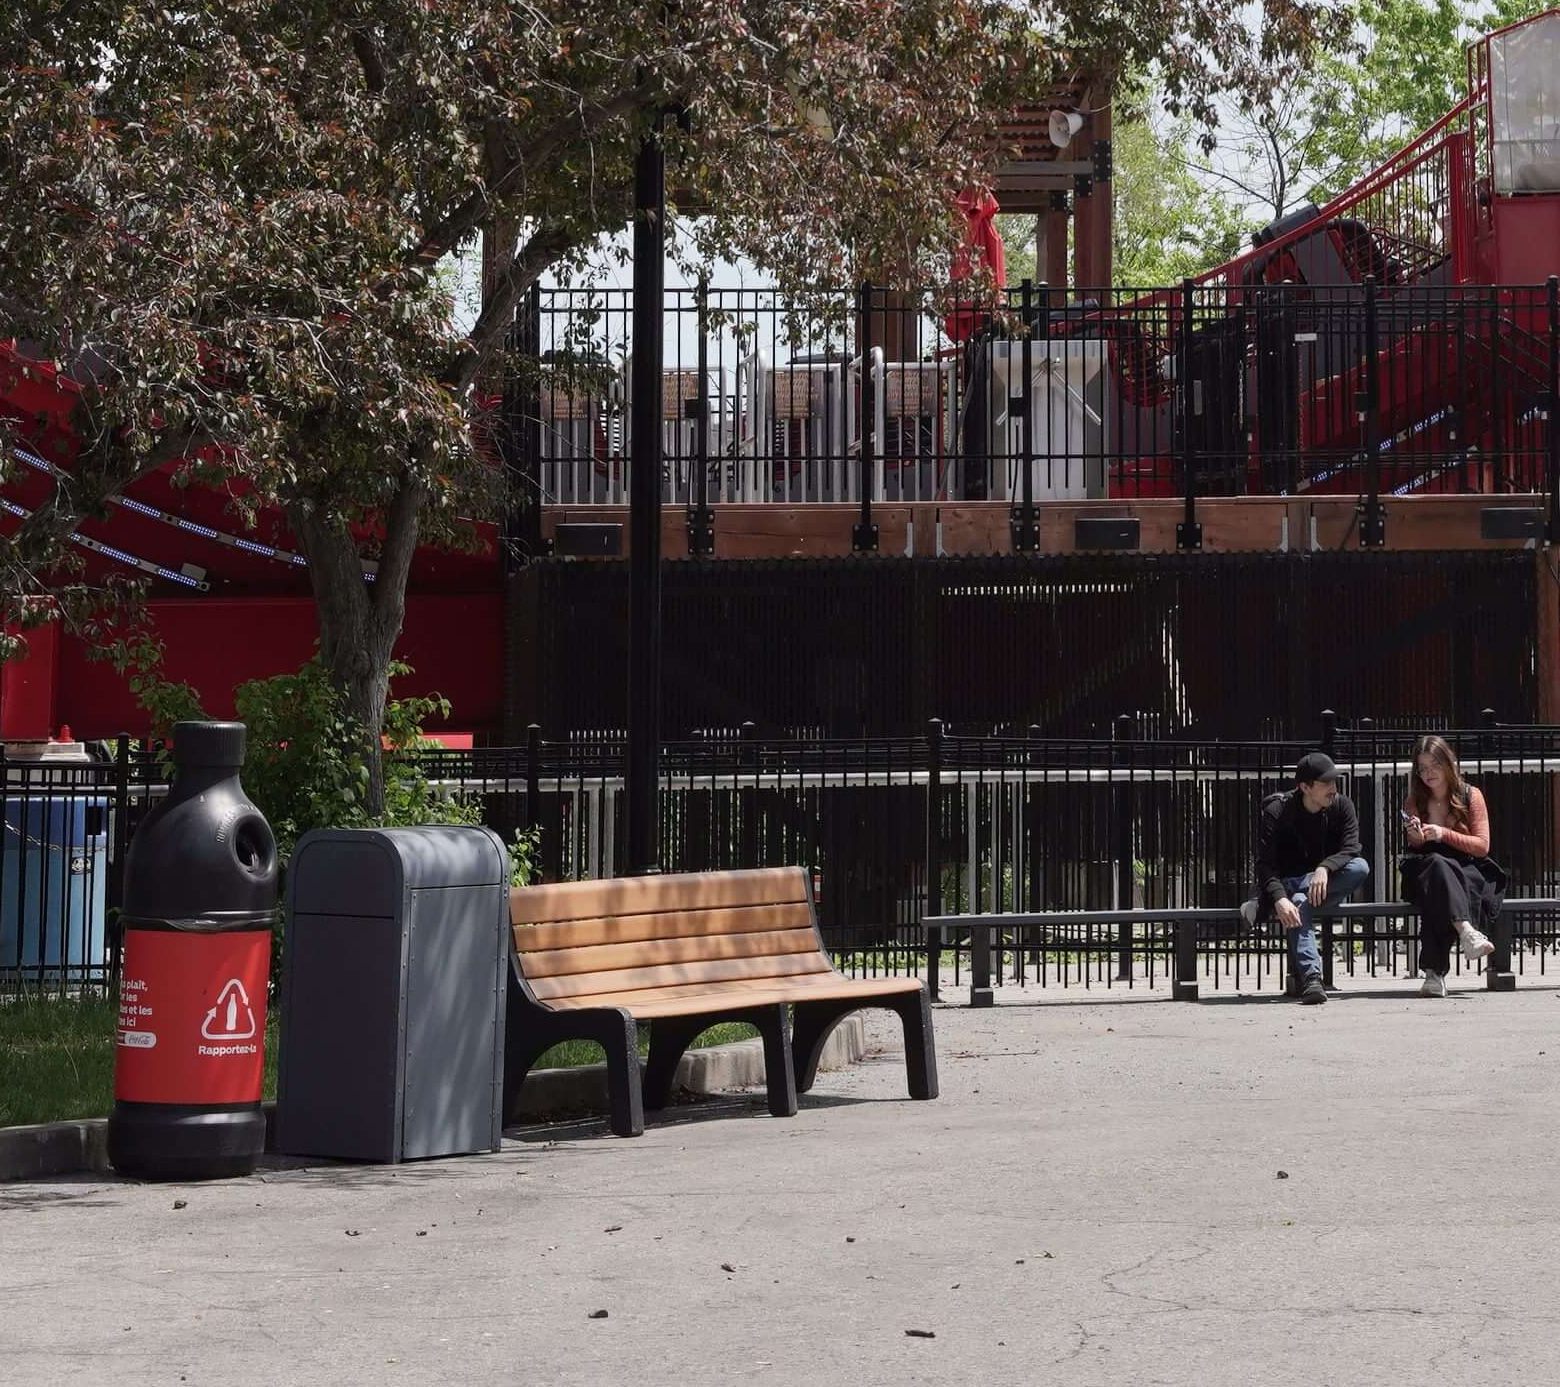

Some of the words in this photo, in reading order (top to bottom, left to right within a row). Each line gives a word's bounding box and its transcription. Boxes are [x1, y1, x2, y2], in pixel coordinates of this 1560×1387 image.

[126, 993, 138, 1002] les
[129, 1006, 138, 1015] et
[139, 1005, 153, 1016] les
[127, 1017, 136, 1027] ici
